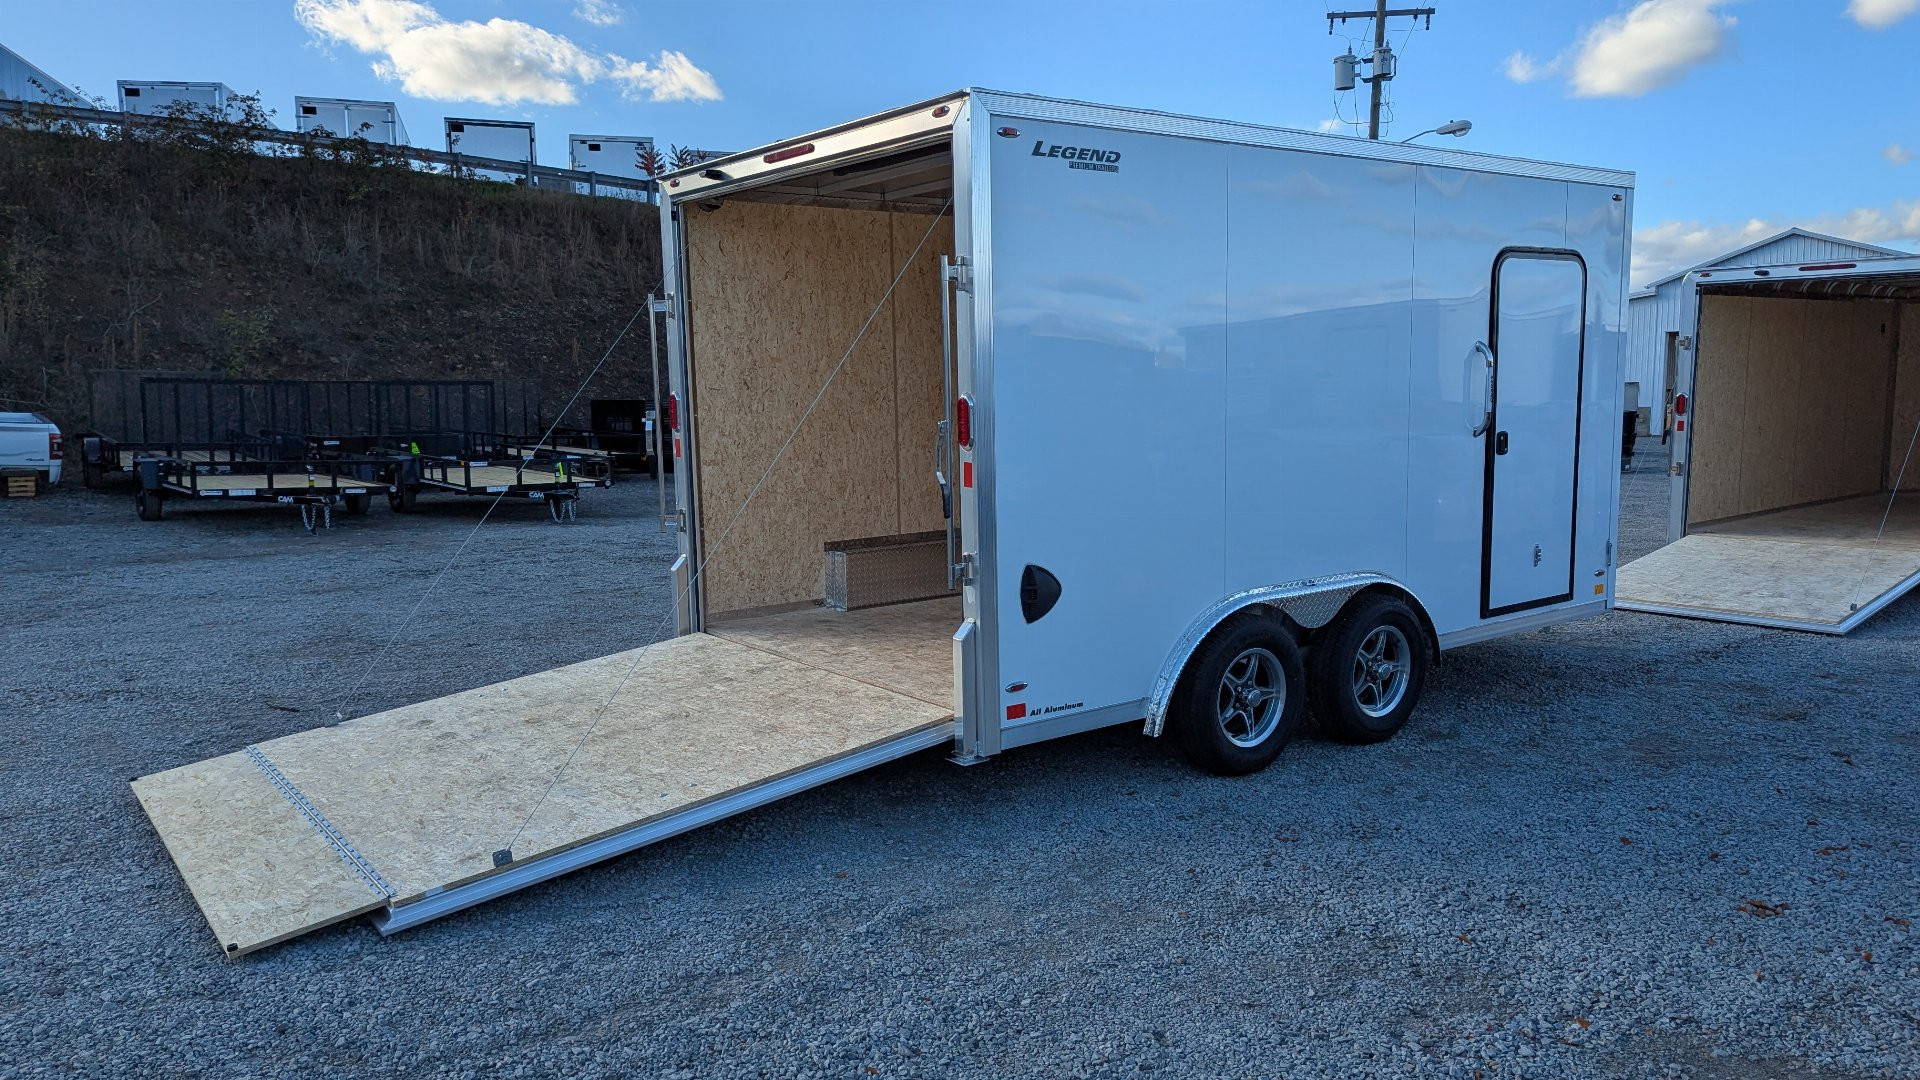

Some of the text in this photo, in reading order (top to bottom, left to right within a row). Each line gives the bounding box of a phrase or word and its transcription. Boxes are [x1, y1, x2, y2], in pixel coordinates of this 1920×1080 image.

[1031, 140, 1122, 164] LEGEND
[277, 495, 294, 503] CAM
[1030, 702, 1084, 717] All Aluminum
